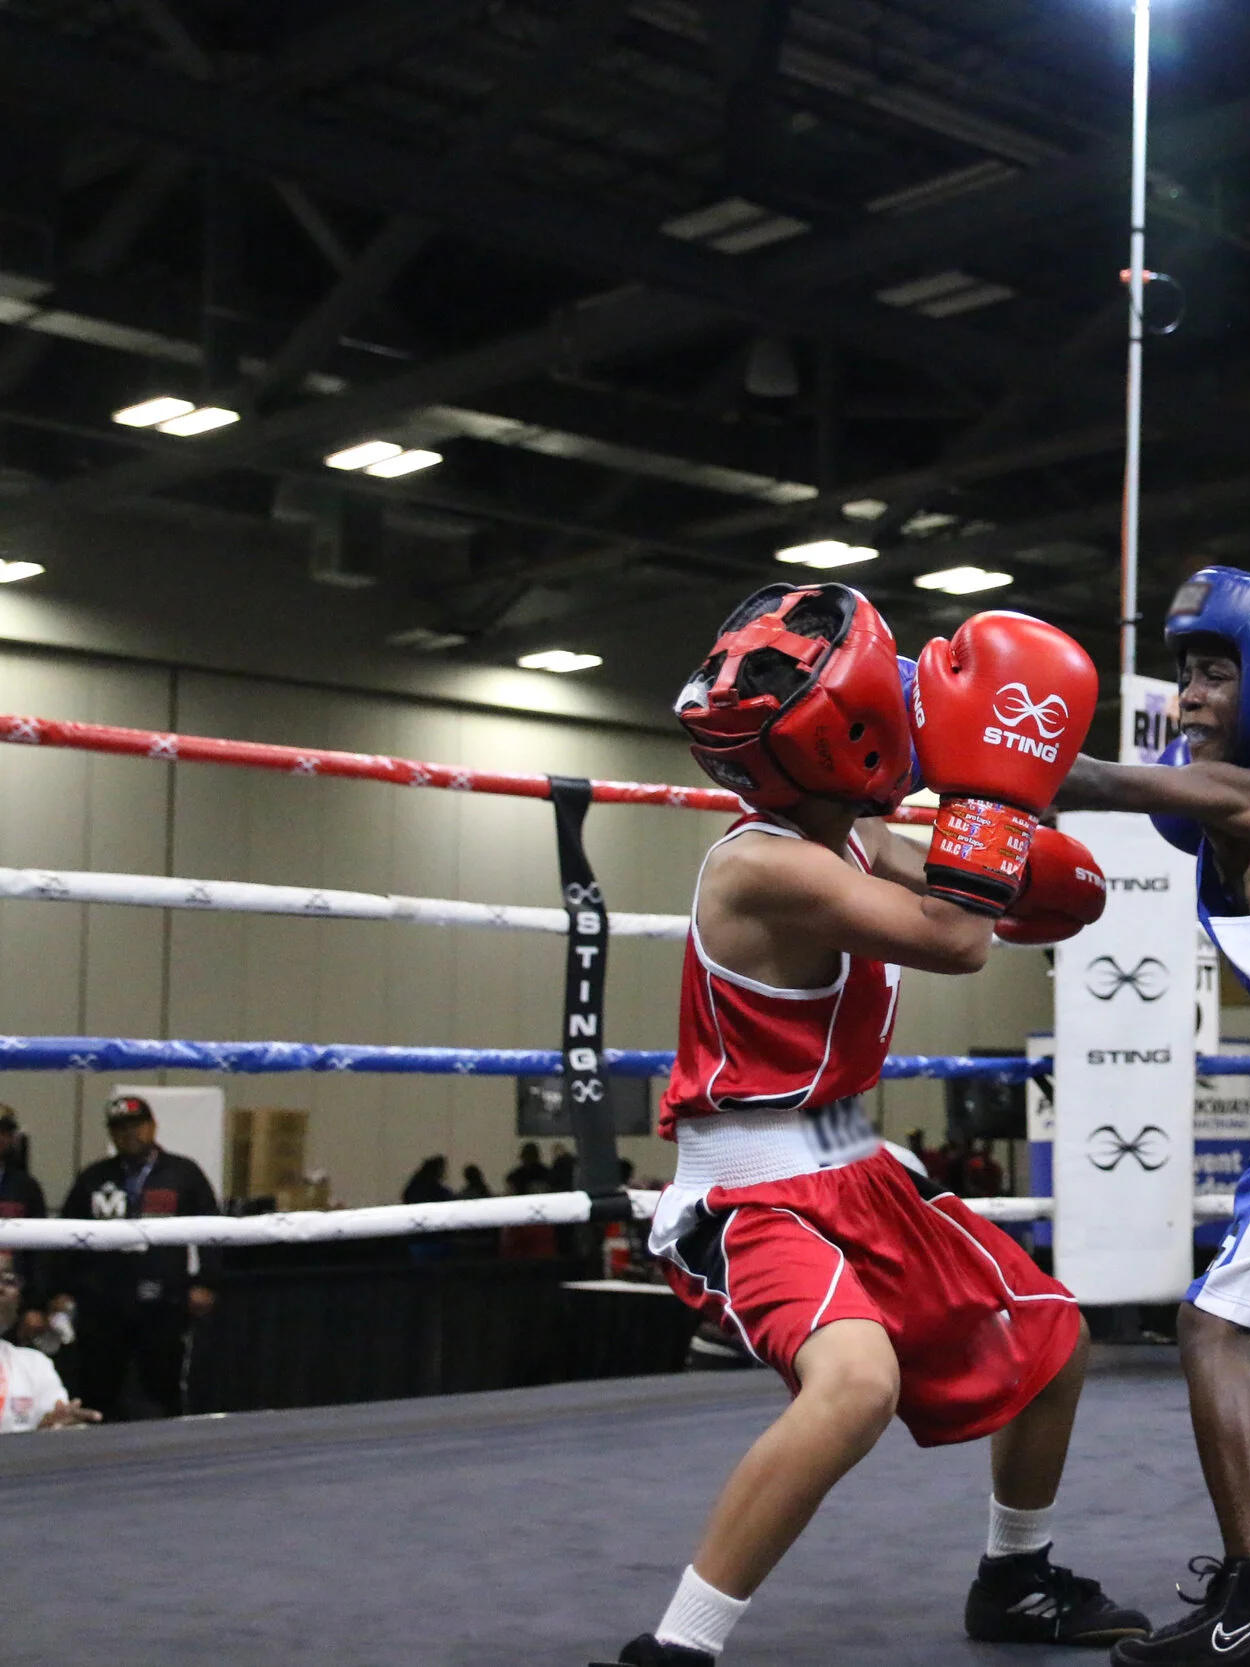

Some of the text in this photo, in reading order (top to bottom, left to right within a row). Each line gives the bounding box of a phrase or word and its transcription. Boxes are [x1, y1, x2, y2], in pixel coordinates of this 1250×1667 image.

[983, 726, 1058, 763] STING
[1105, 877, 1169, 891] TING
[568, 911, 600, 1072] STING
[1087, 1049, 1170, 1064] STING
